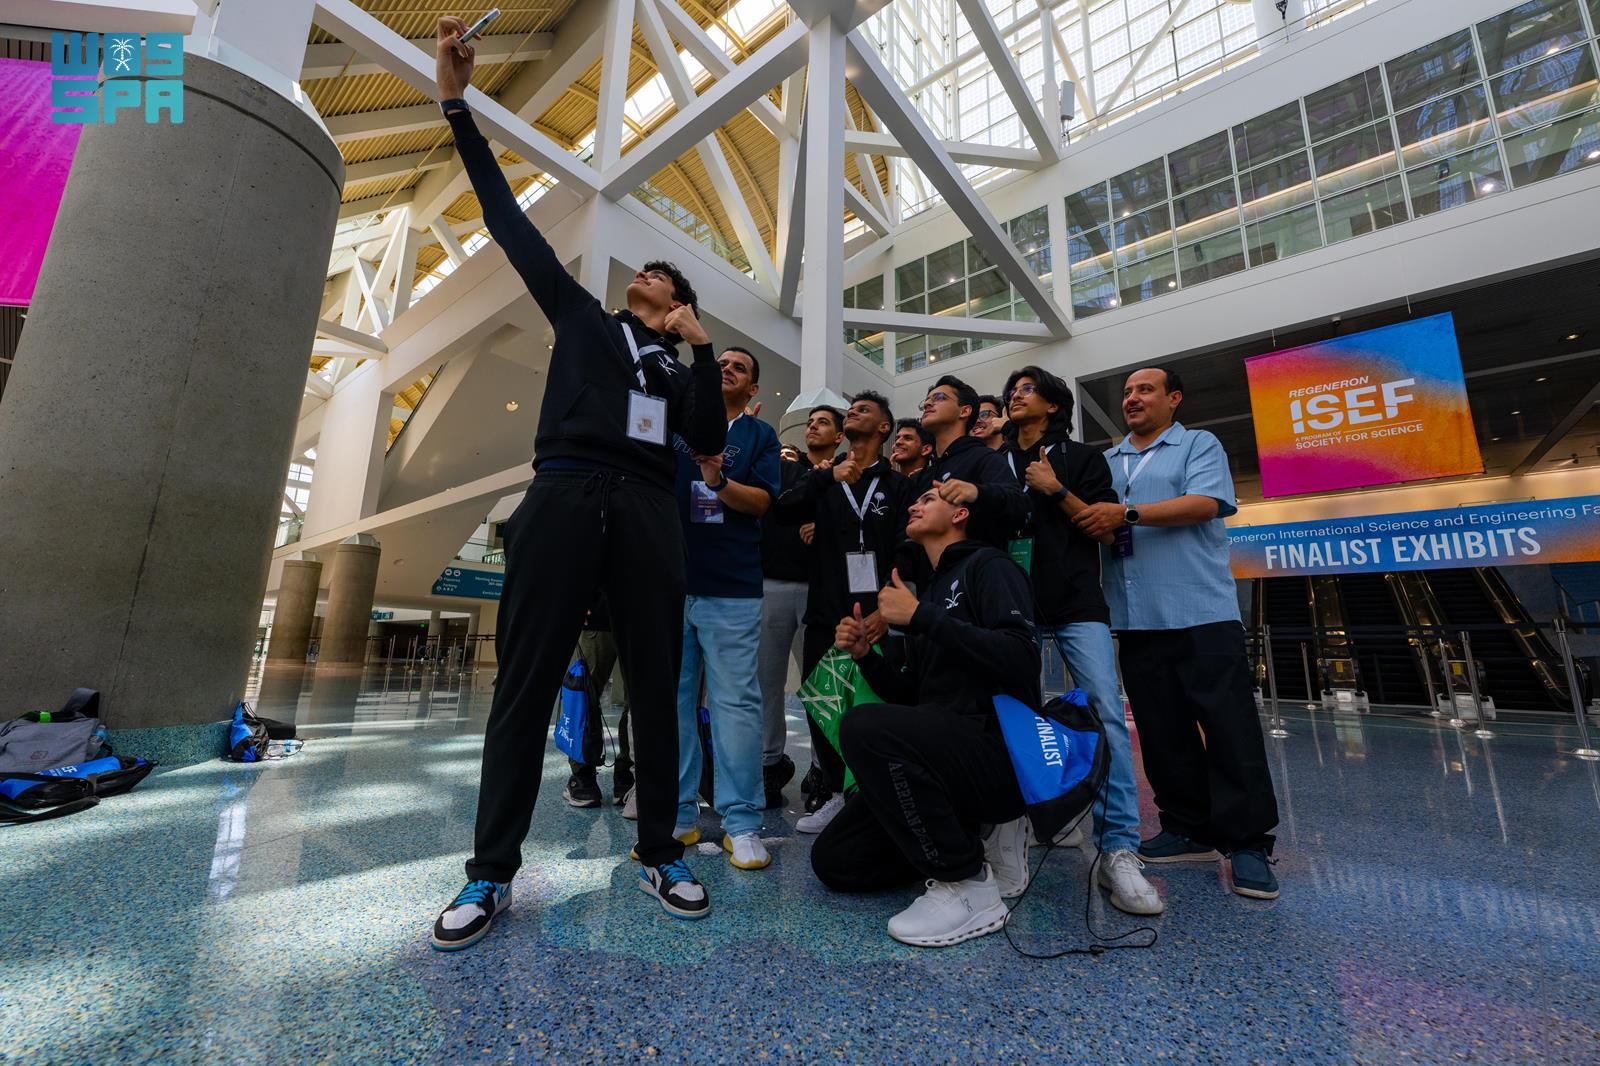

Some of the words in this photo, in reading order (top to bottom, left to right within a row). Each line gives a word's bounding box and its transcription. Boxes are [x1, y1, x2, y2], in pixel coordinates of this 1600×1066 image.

[1289, 376, 1369, 398] REGENERON
[1290, 378, 1415, 434] ISEF
[1296, 436, 1342, 449] SOCIETY
[1345, 432, 1368, 442] FOR
[1371, 423, 1424, 438] SCIENCE
[1280, 523, 1364, 539] International
[1368, 517, 1429, 532] Science
[1434, 515, 1464, 526] and
[1470, 505, 1576, 525] Engineering
[1582, 503, 1600, 516] Fa
[1265, 538, 1382, 570] FINALIST
[1391, 527, 1541, 563] EXHIBITS
